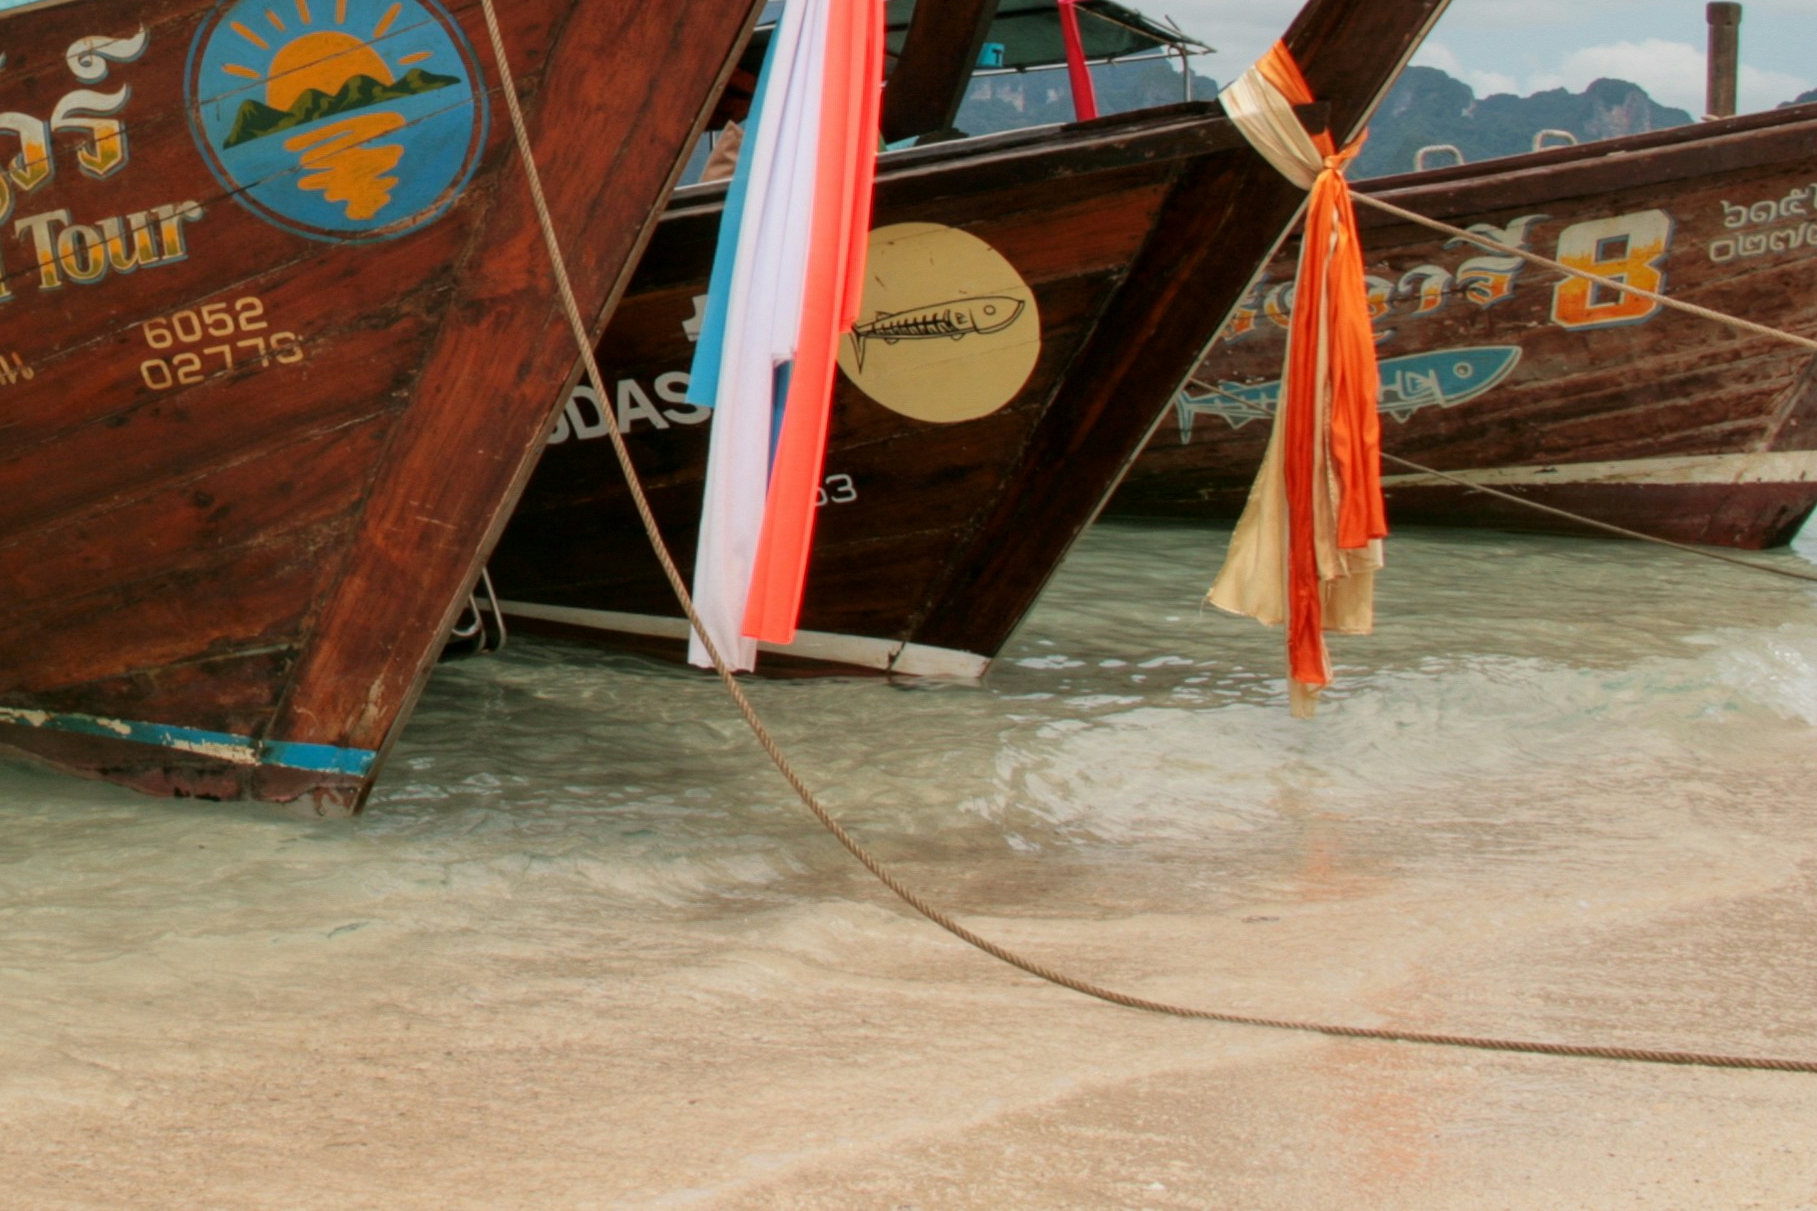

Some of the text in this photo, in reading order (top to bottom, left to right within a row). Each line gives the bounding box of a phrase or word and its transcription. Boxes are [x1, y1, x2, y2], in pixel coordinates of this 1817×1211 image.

[14, 200, 205, 291] Tour
[1549, 207, 1678, 332] 8
[142, 296, 269, 350] 6052
